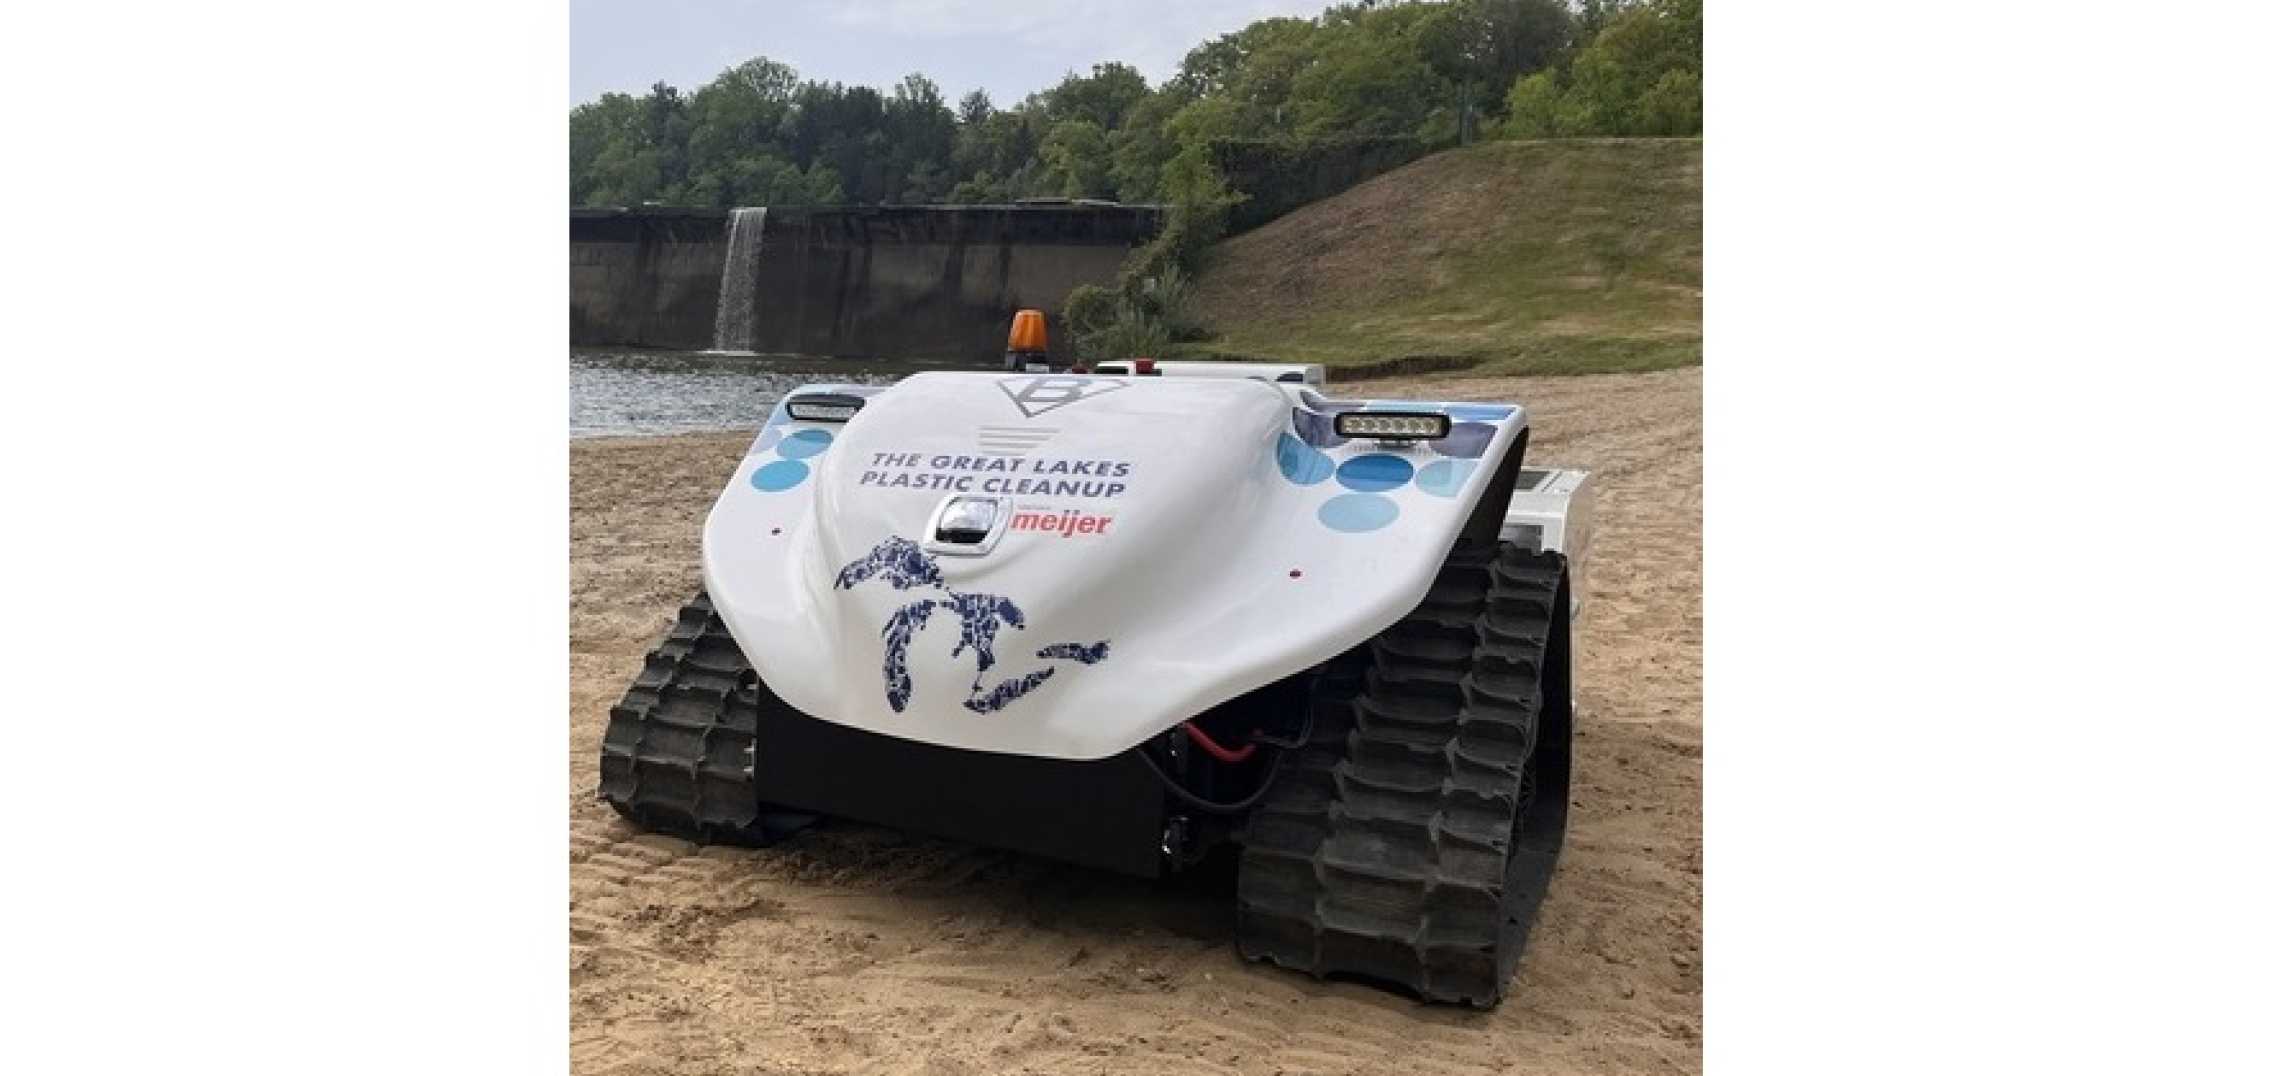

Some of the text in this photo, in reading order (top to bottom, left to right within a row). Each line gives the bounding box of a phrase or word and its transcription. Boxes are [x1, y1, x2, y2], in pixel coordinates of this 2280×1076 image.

[872, 453, 1130, 477] THE GREAT LAKES
[860, 471, 1126, 498] PLASTIC CLEANUP
[1011, 510, 1113, 537] meijer
